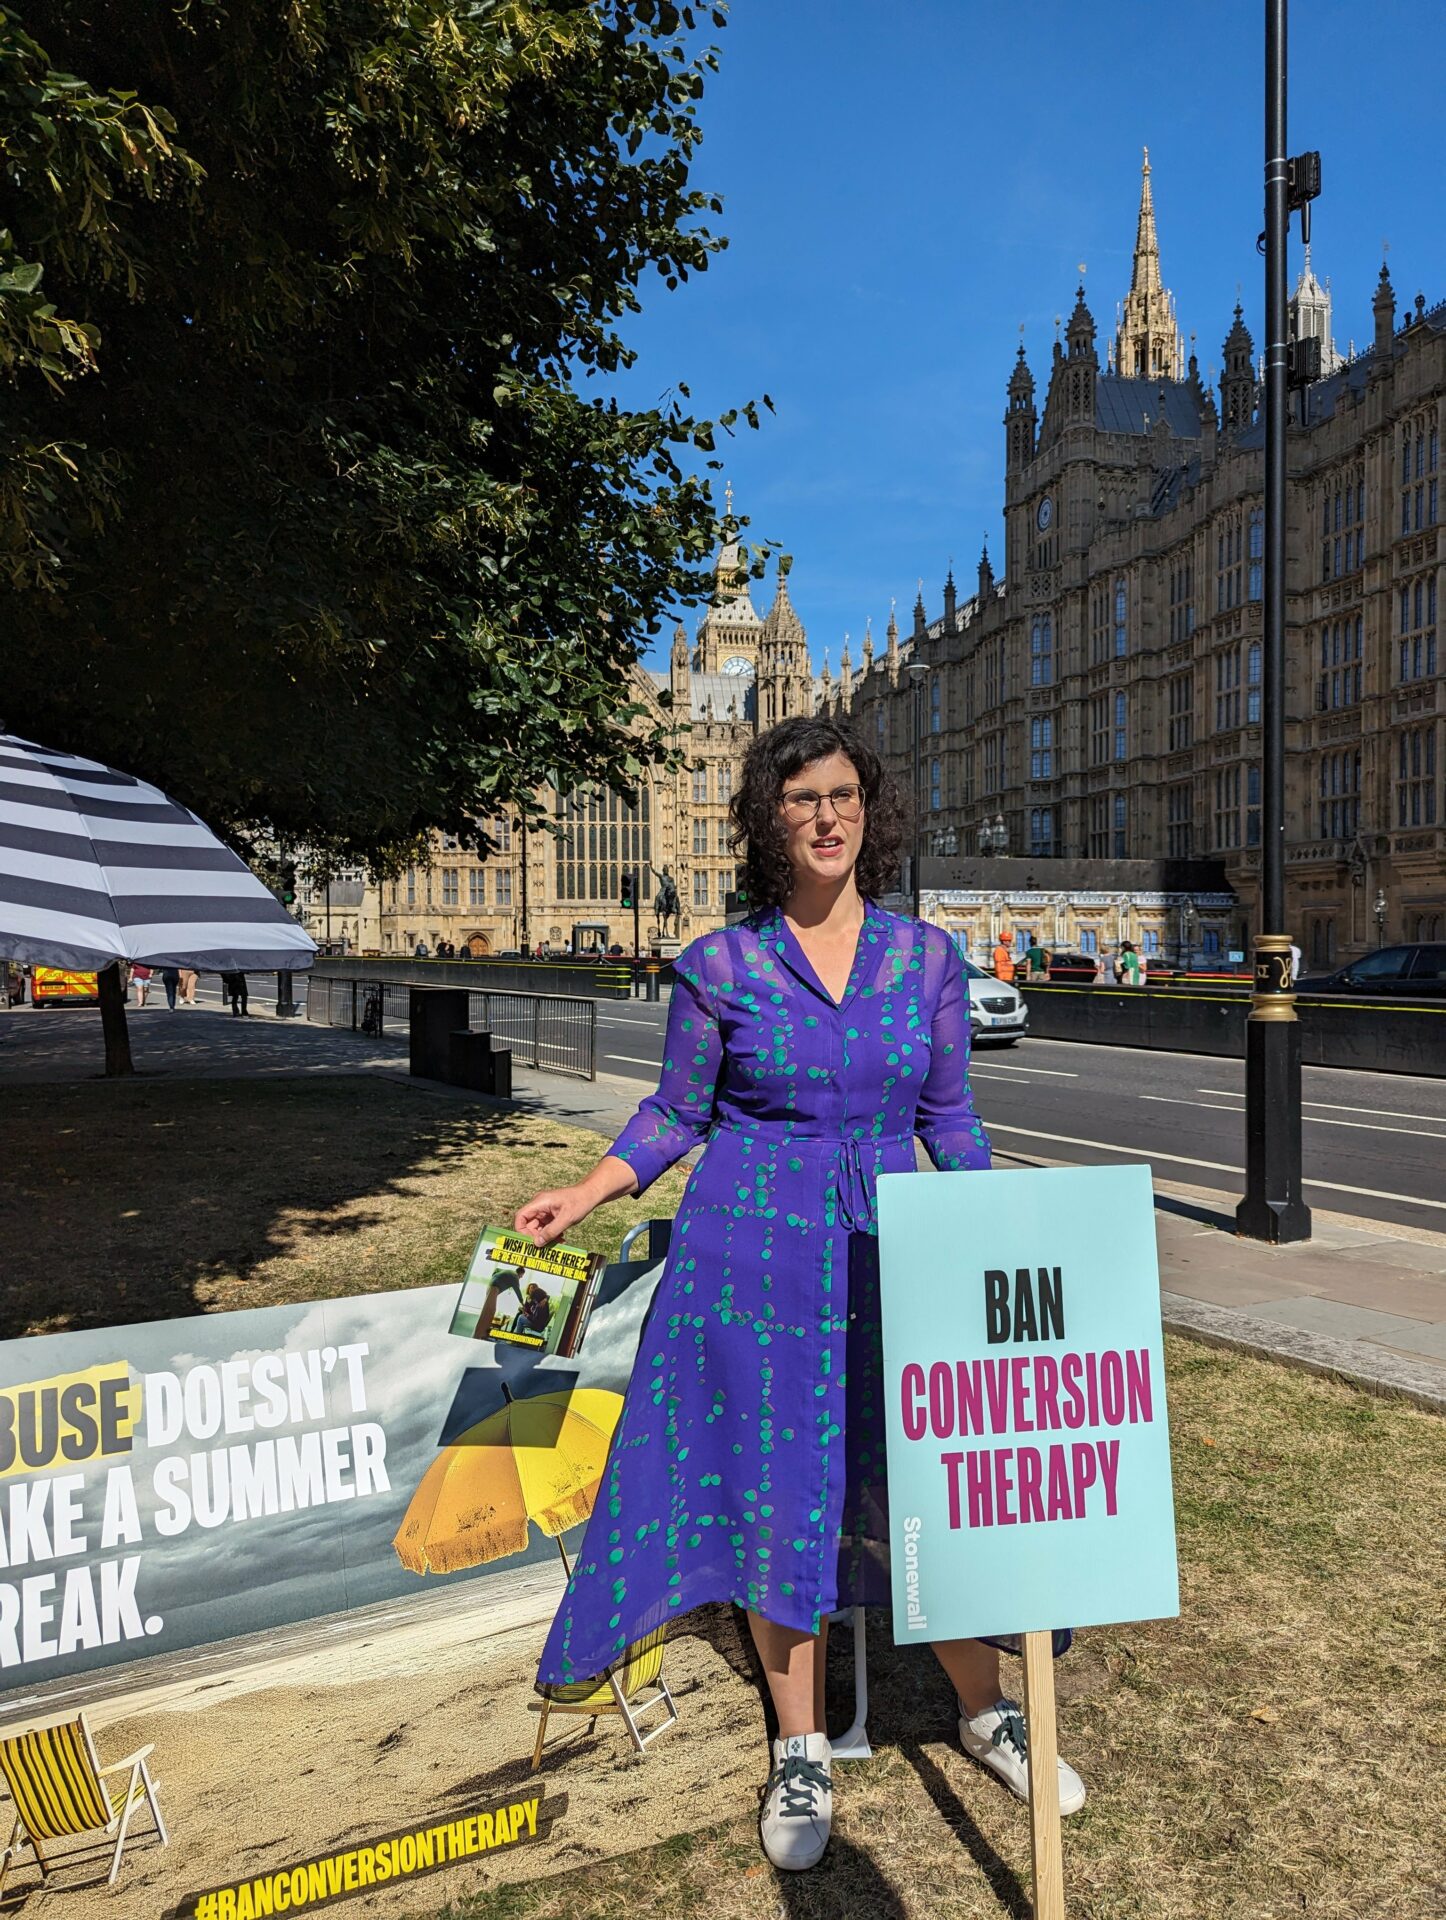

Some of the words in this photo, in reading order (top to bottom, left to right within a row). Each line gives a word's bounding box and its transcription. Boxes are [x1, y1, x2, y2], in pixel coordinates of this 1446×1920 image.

[503, 1238, 524, 1251] WISH
[524, 1242, 540, 1256] YOU
[539, 1247, 560, 1263] WERE
[560, 1251, 586, 1269] HERE?
[510, 1253, 526, 1266] STILL
[526, 1257, 550, 1272] WAITING
[550, 1263, 563, 1275] FOR
[563, 1266, 574, 1278] THE
[983, 1266, 1066, 1345] BAN
[901, 1348, 1154, 1441] CONVERSION
[100, 1465, 143, 1549] A
[153, 1422, 392, 1537] SUMMER
[940, 1439, 1121, 1530] THERAPY
[903, 1516, 928, 1631] Stonewall
[193, 1797, 540, 1920] #BANCONVERSIONTHERAPY
